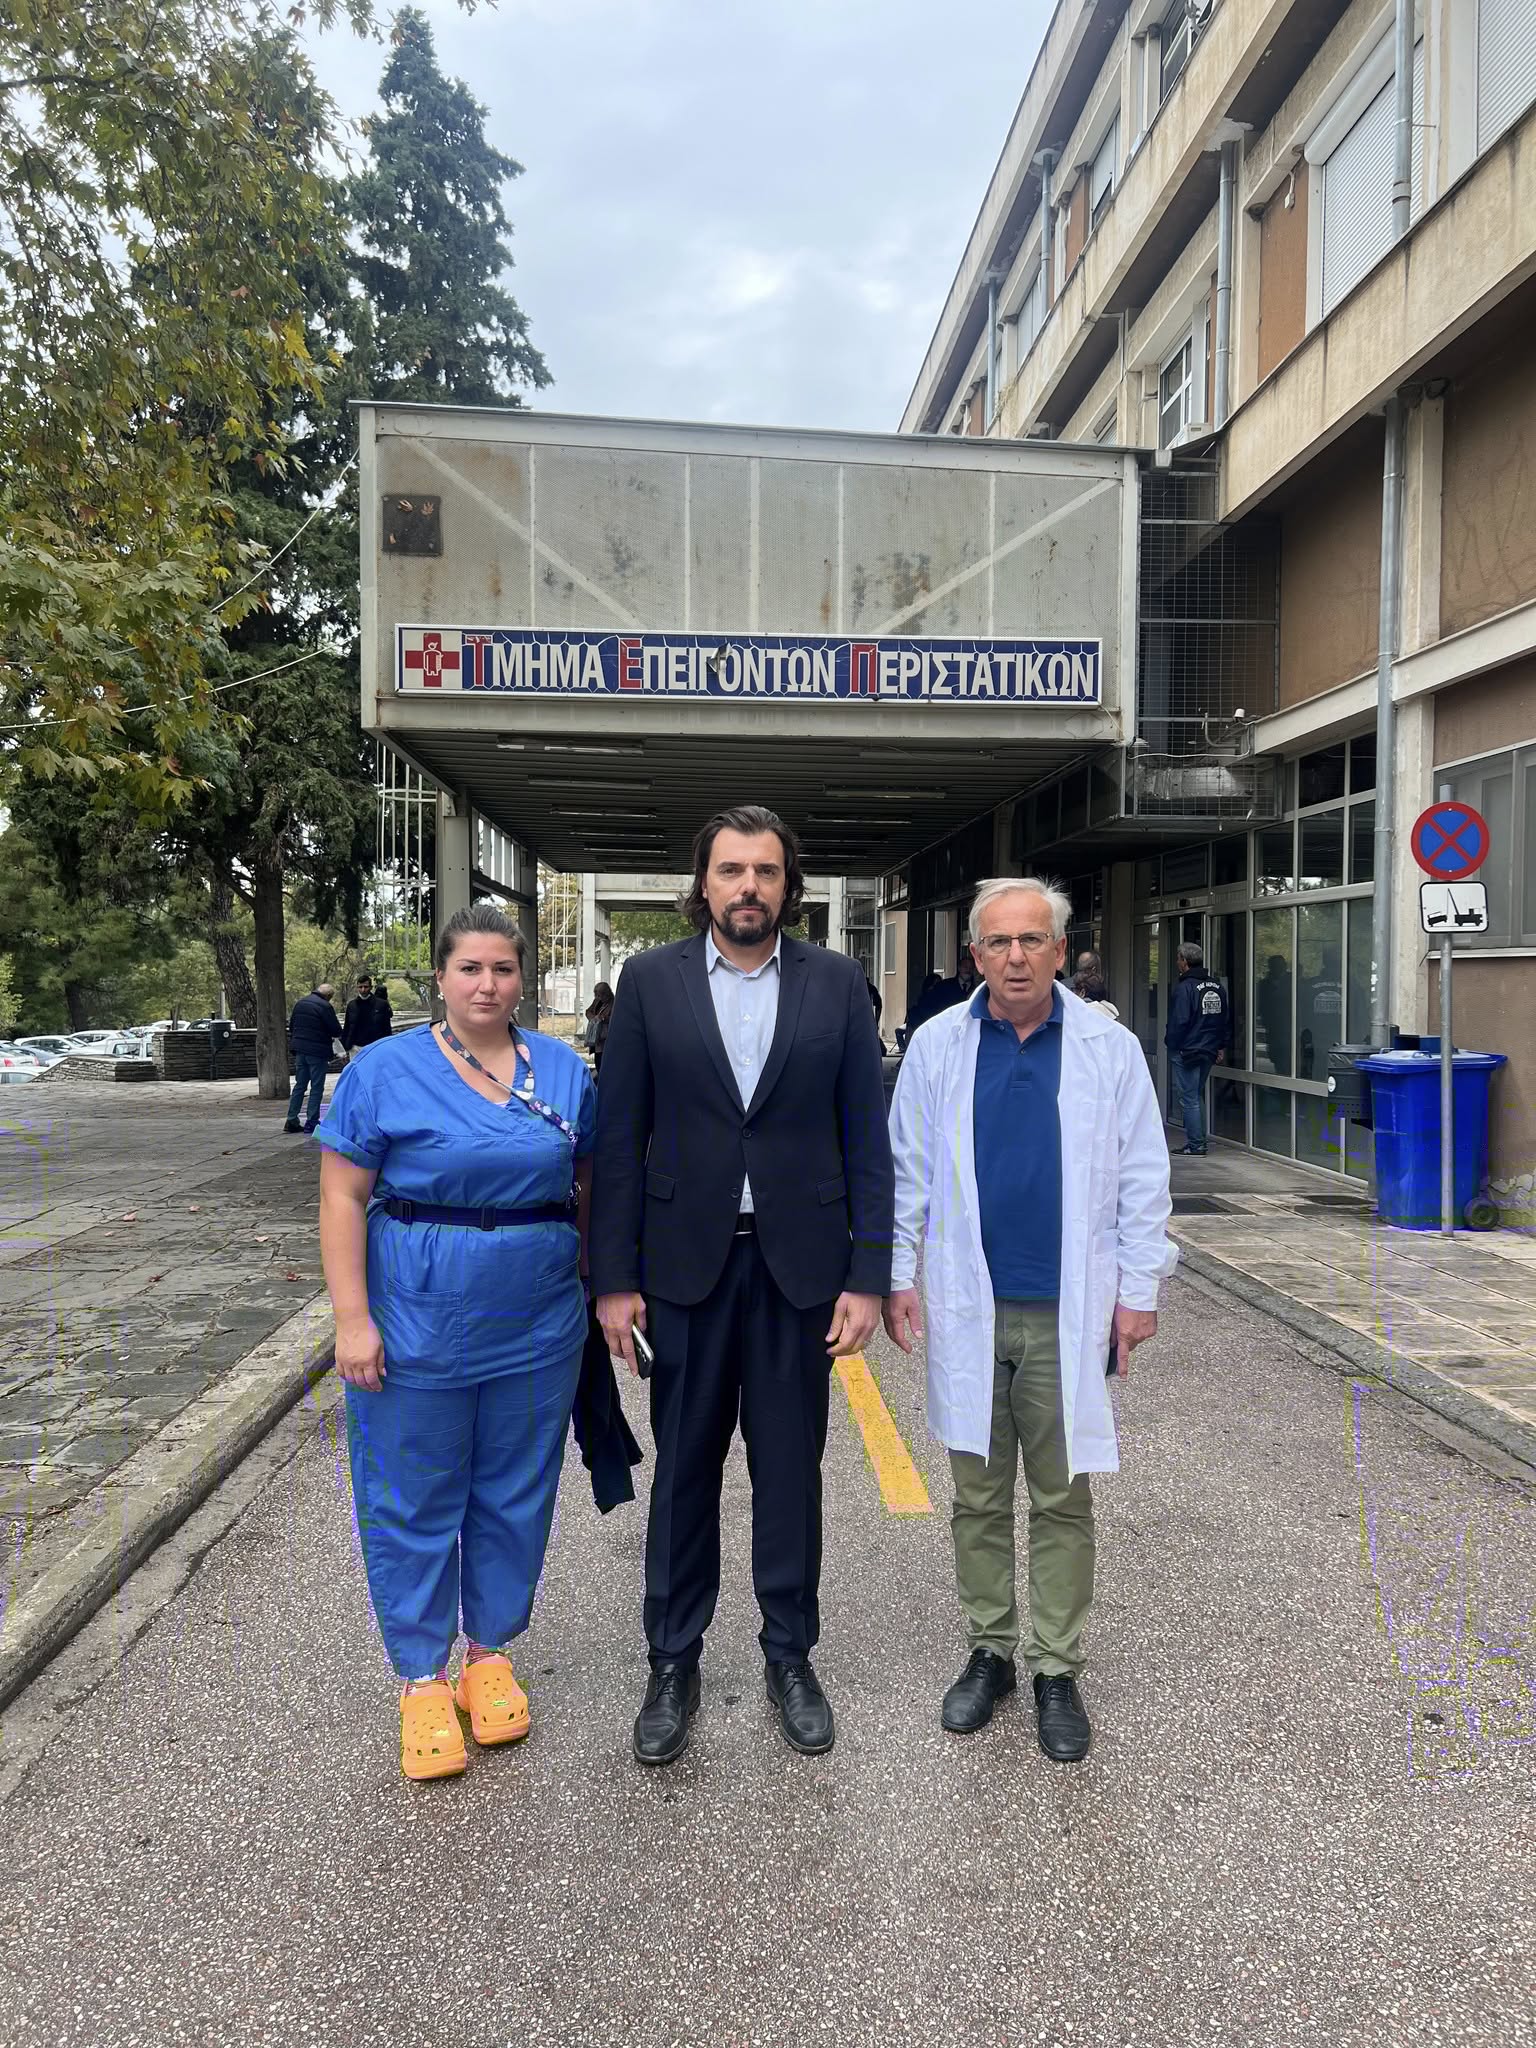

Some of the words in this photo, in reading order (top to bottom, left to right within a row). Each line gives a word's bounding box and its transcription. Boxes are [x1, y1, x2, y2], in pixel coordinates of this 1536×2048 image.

[465, 635, 605, 689] ΤΜΗΜΑ
[619, 638, 835, 693] ΕΠΕΙΓΟΝΤΩΝ
[851, 643, 1096, 697] ΠΕΡΙΣΤΑΤΙΚΩΝ
